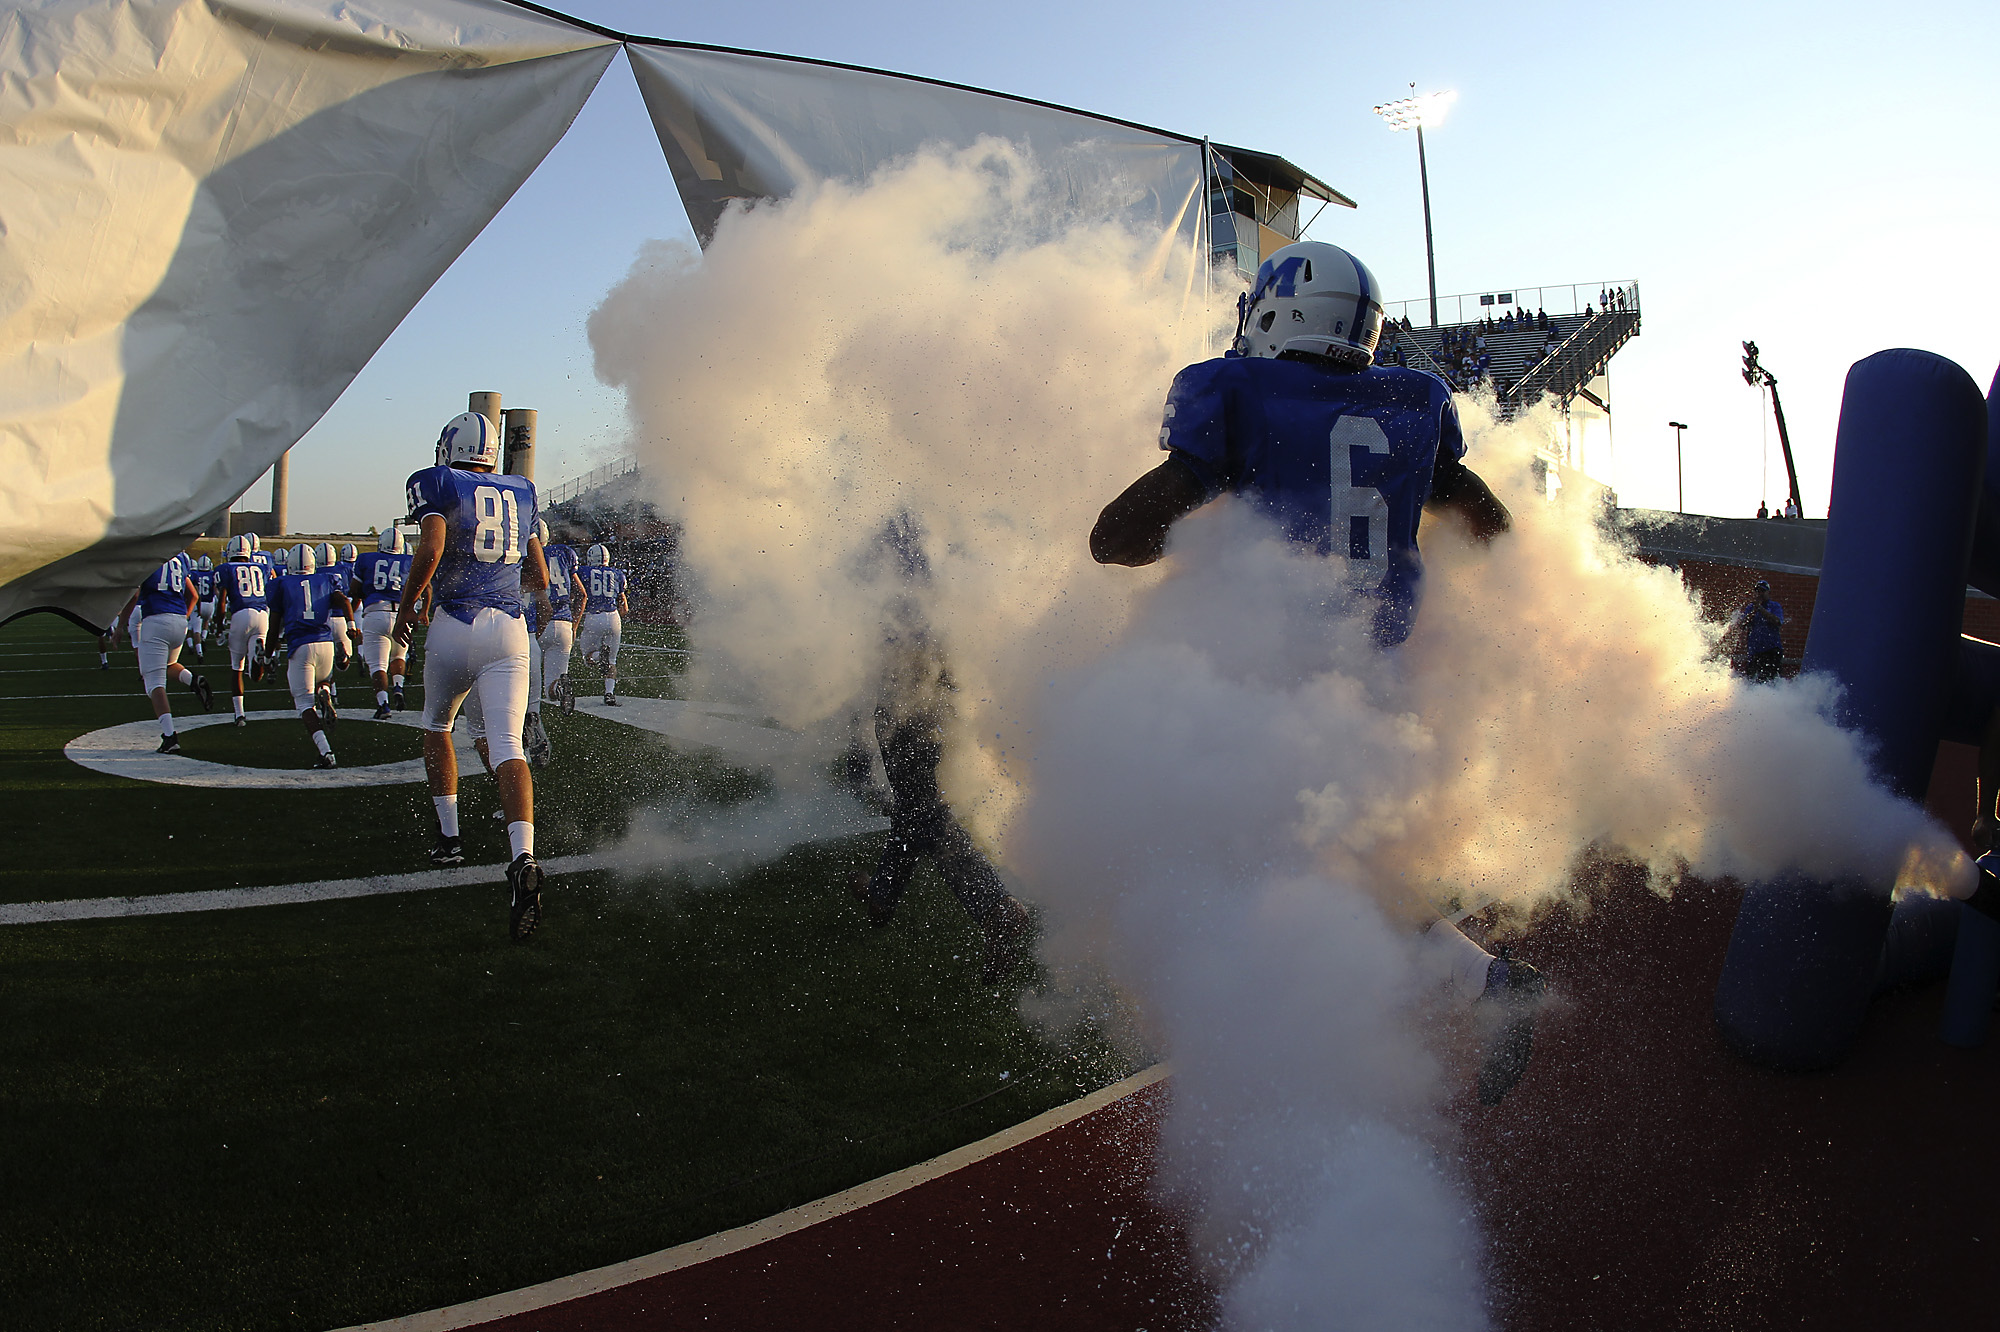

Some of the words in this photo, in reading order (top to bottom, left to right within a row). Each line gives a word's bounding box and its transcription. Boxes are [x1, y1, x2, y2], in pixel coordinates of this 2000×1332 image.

[1334, 320, 1343, 334] 6
[1329, 414, 1391, 590] 6
[474, 486, 522, 565] 81
[236, 565, 265, 597] 80
[373, 559, 402, 591] 64
[590, 568, 615, 598] 60
[300, 579, 315, 620] 1
